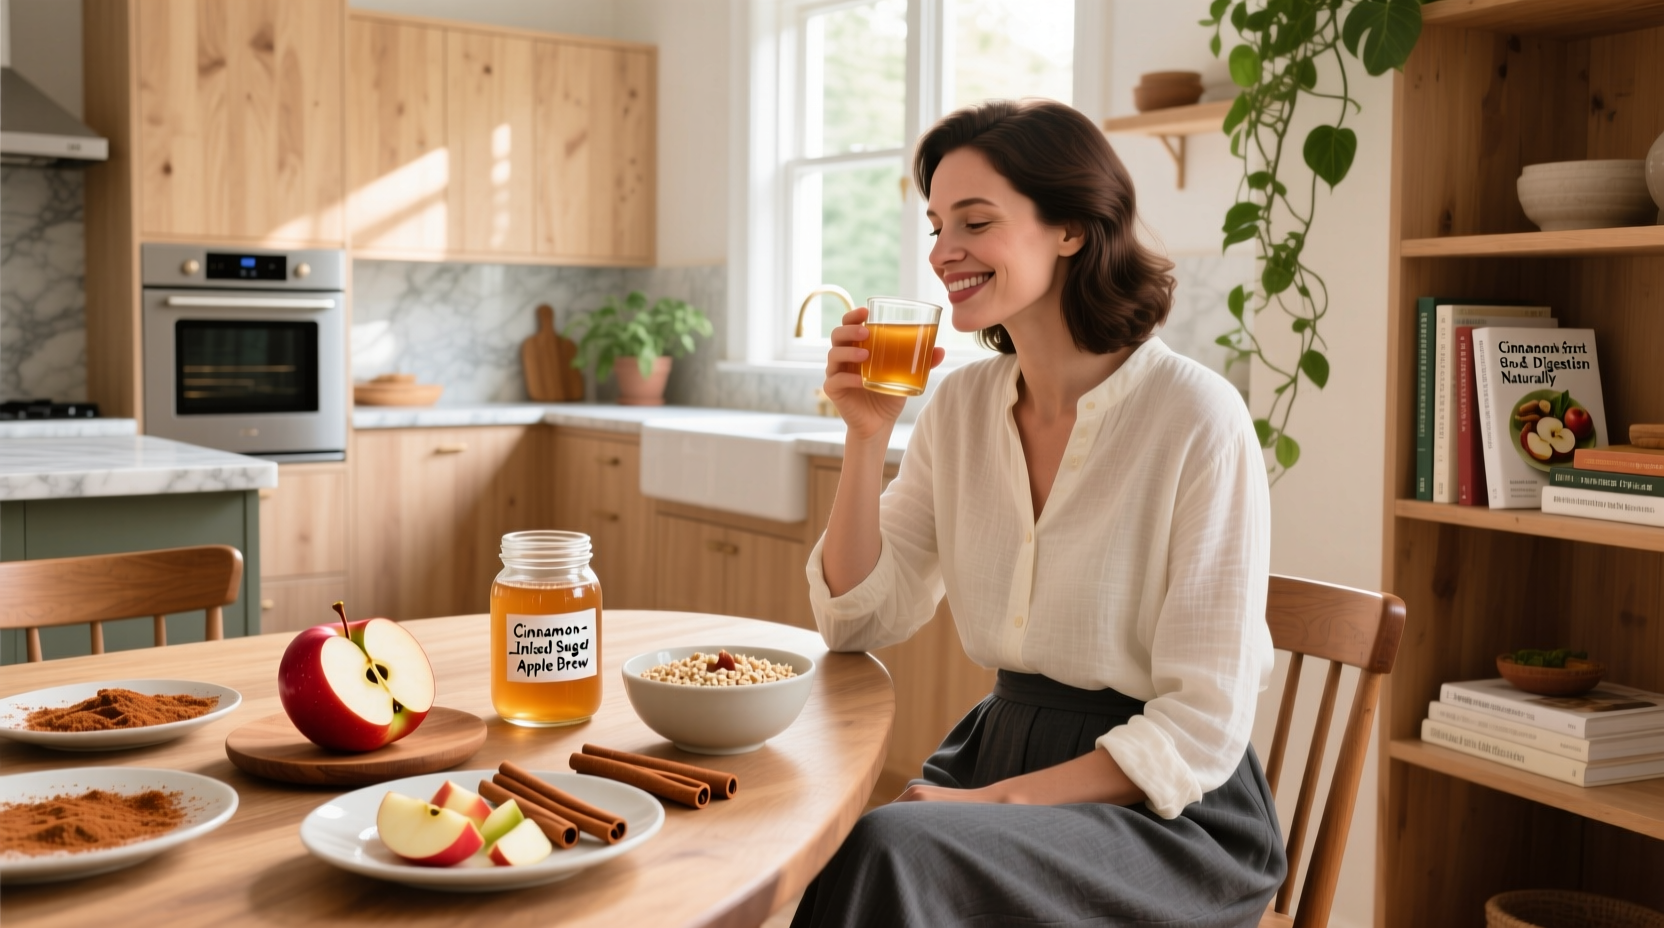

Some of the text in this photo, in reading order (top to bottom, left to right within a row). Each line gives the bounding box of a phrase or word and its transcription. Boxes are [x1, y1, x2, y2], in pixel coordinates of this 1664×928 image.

[1501, 370, 1556, 388] Naturally
[513, 623, 587, 638] Cinnamon-
[517, 656, 589, 677] Apple Brew
